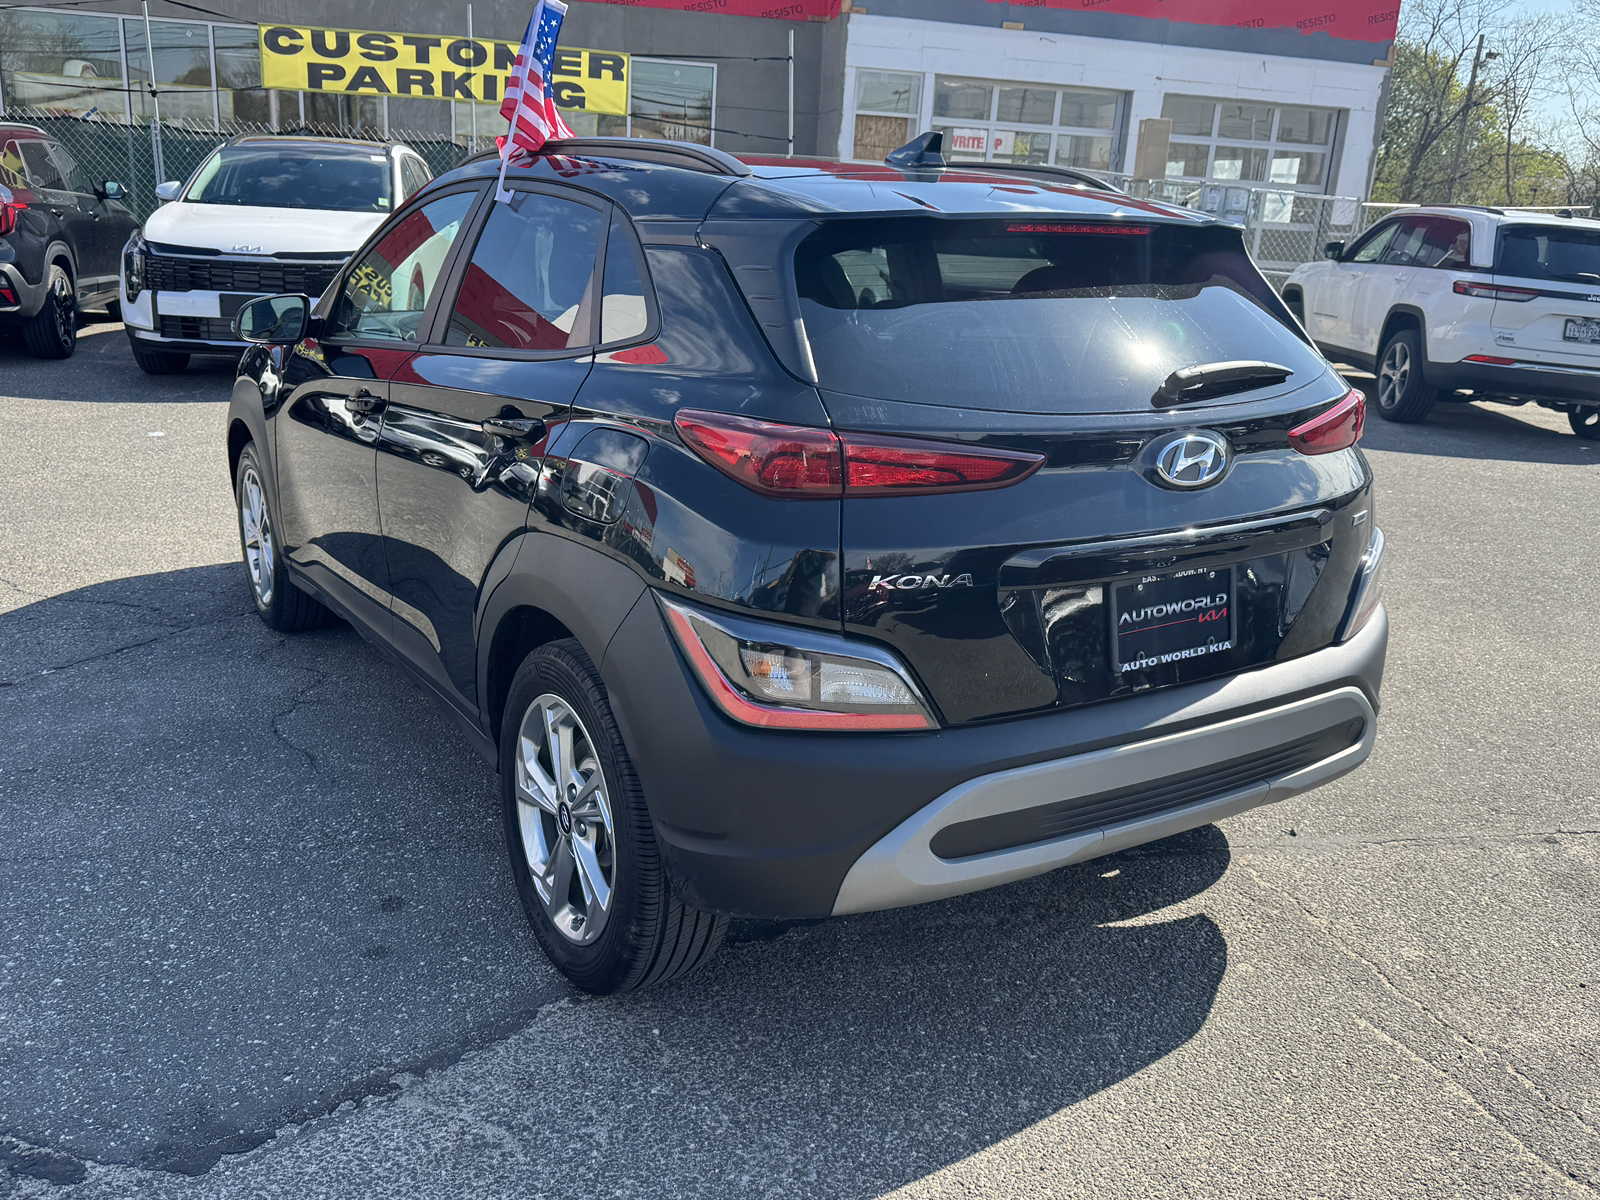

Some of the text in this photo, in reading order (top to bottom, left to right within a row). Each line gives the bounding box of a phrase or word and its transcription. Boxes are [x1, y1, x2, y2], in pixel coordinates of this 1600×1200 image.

[1296, 13, 1336, 30] RESISTO
[868, 573, 974, 590] KONA
[1118, 593, 1228, 626] AUTOWORLD
[1198, 607, 1228, 623] KIA
[1121, 641, 1232, 673] AUTO WORLD KIA
